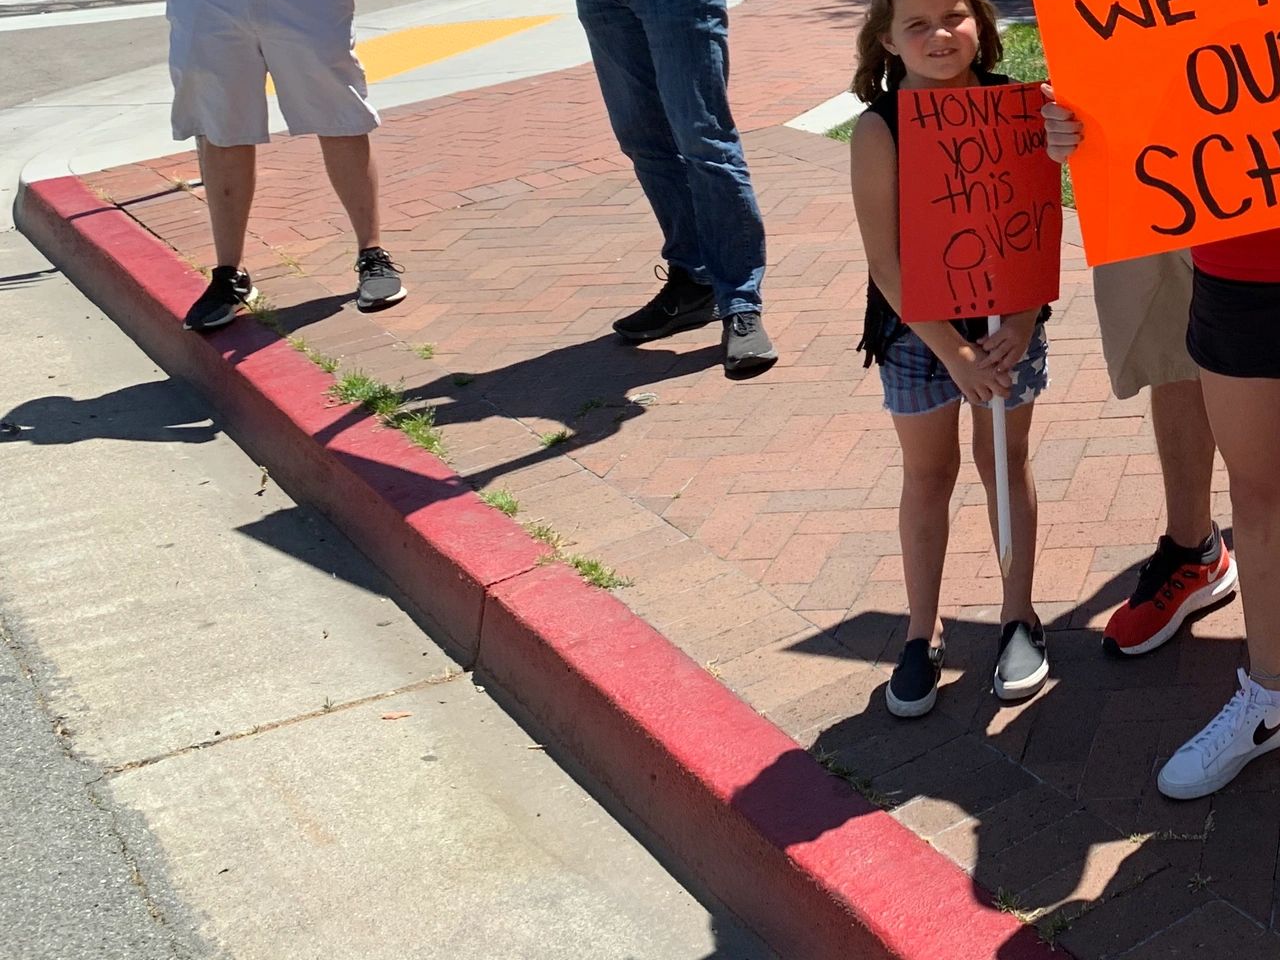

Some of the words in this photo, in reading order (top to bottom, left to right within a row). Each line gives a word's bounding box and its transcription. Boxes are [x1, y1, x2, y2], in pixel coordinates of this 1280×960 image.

[910, 89, 1009, 131] HONK
[938, 128, 1003, 180] YOU
[930, 170, 1014, 214] this
